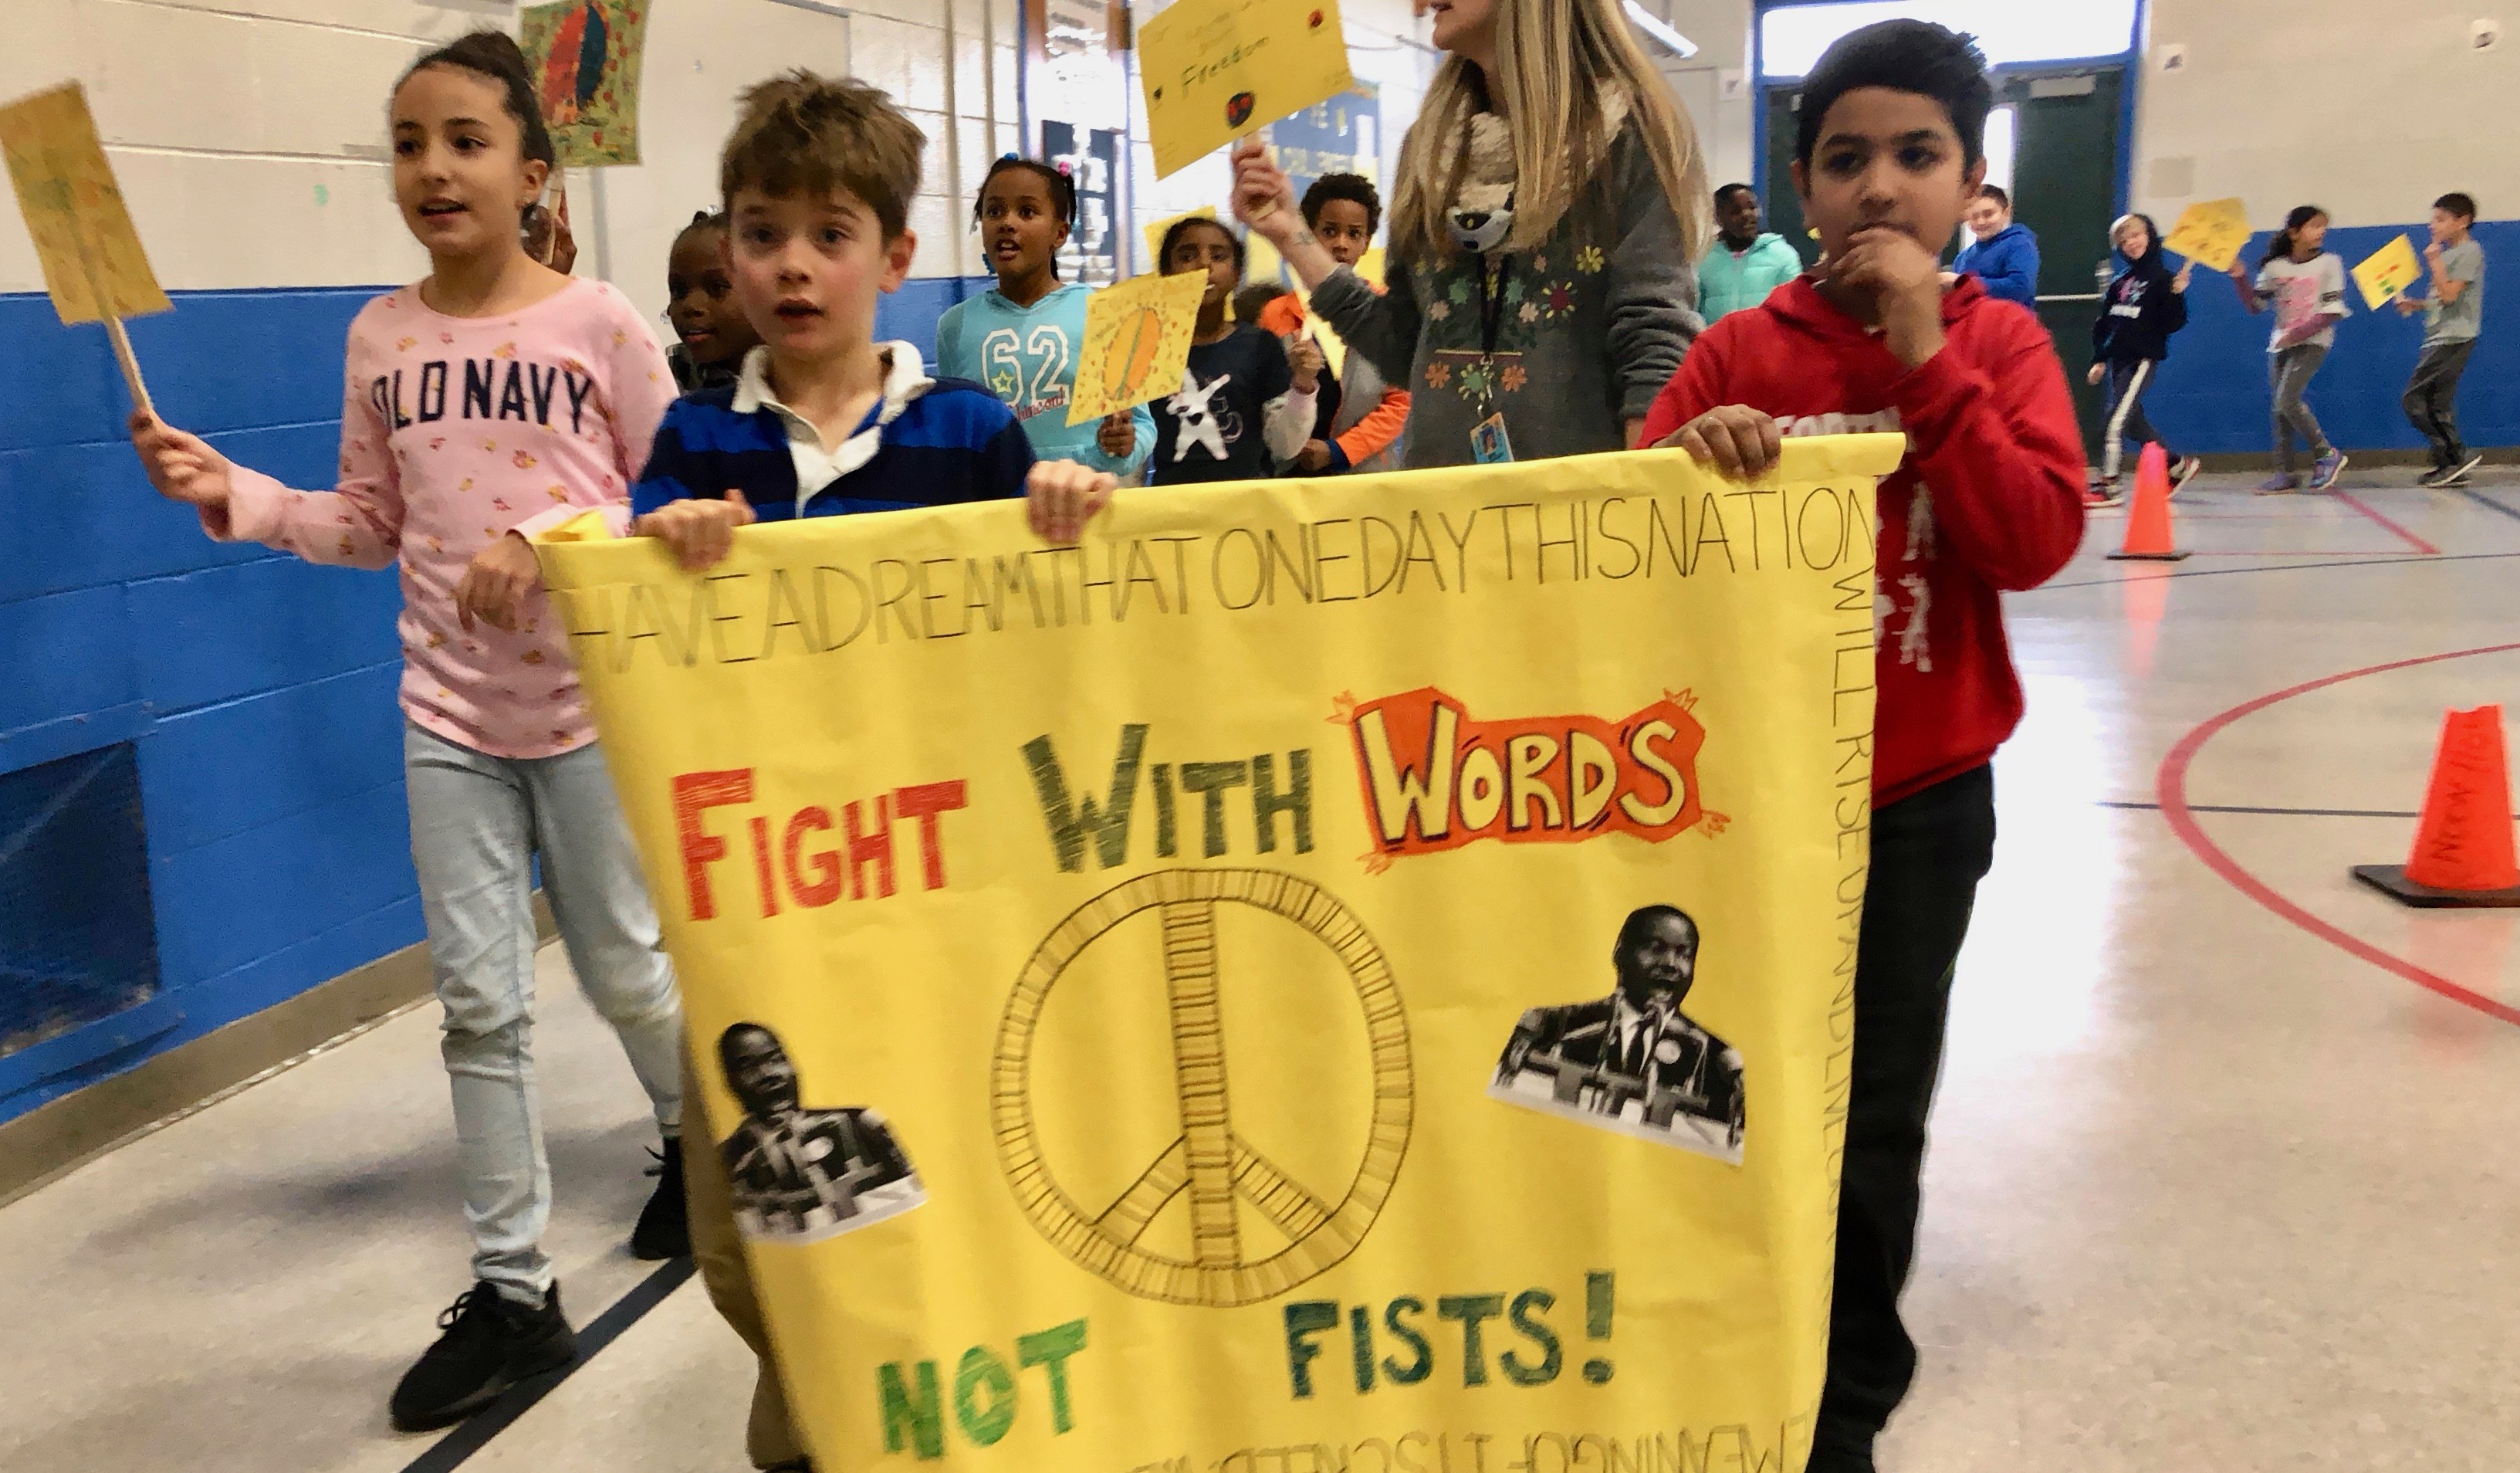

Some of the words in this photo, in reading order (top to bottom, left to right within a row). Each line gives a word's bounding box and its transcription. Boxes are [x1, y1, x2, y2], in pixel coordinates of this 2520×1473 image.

[462, 357, 593, 434] NAVY
[982, 324, 1070, 407] 62
[670, 767, 969, 922] FIGHT
[1019, 722, 1314, 875] WITH
[1354, 699, 1687, 846] WORDS
[874, 1316, 1090, 1461] NOT
[1282, 1268, 1615, 1400] FISTS!
